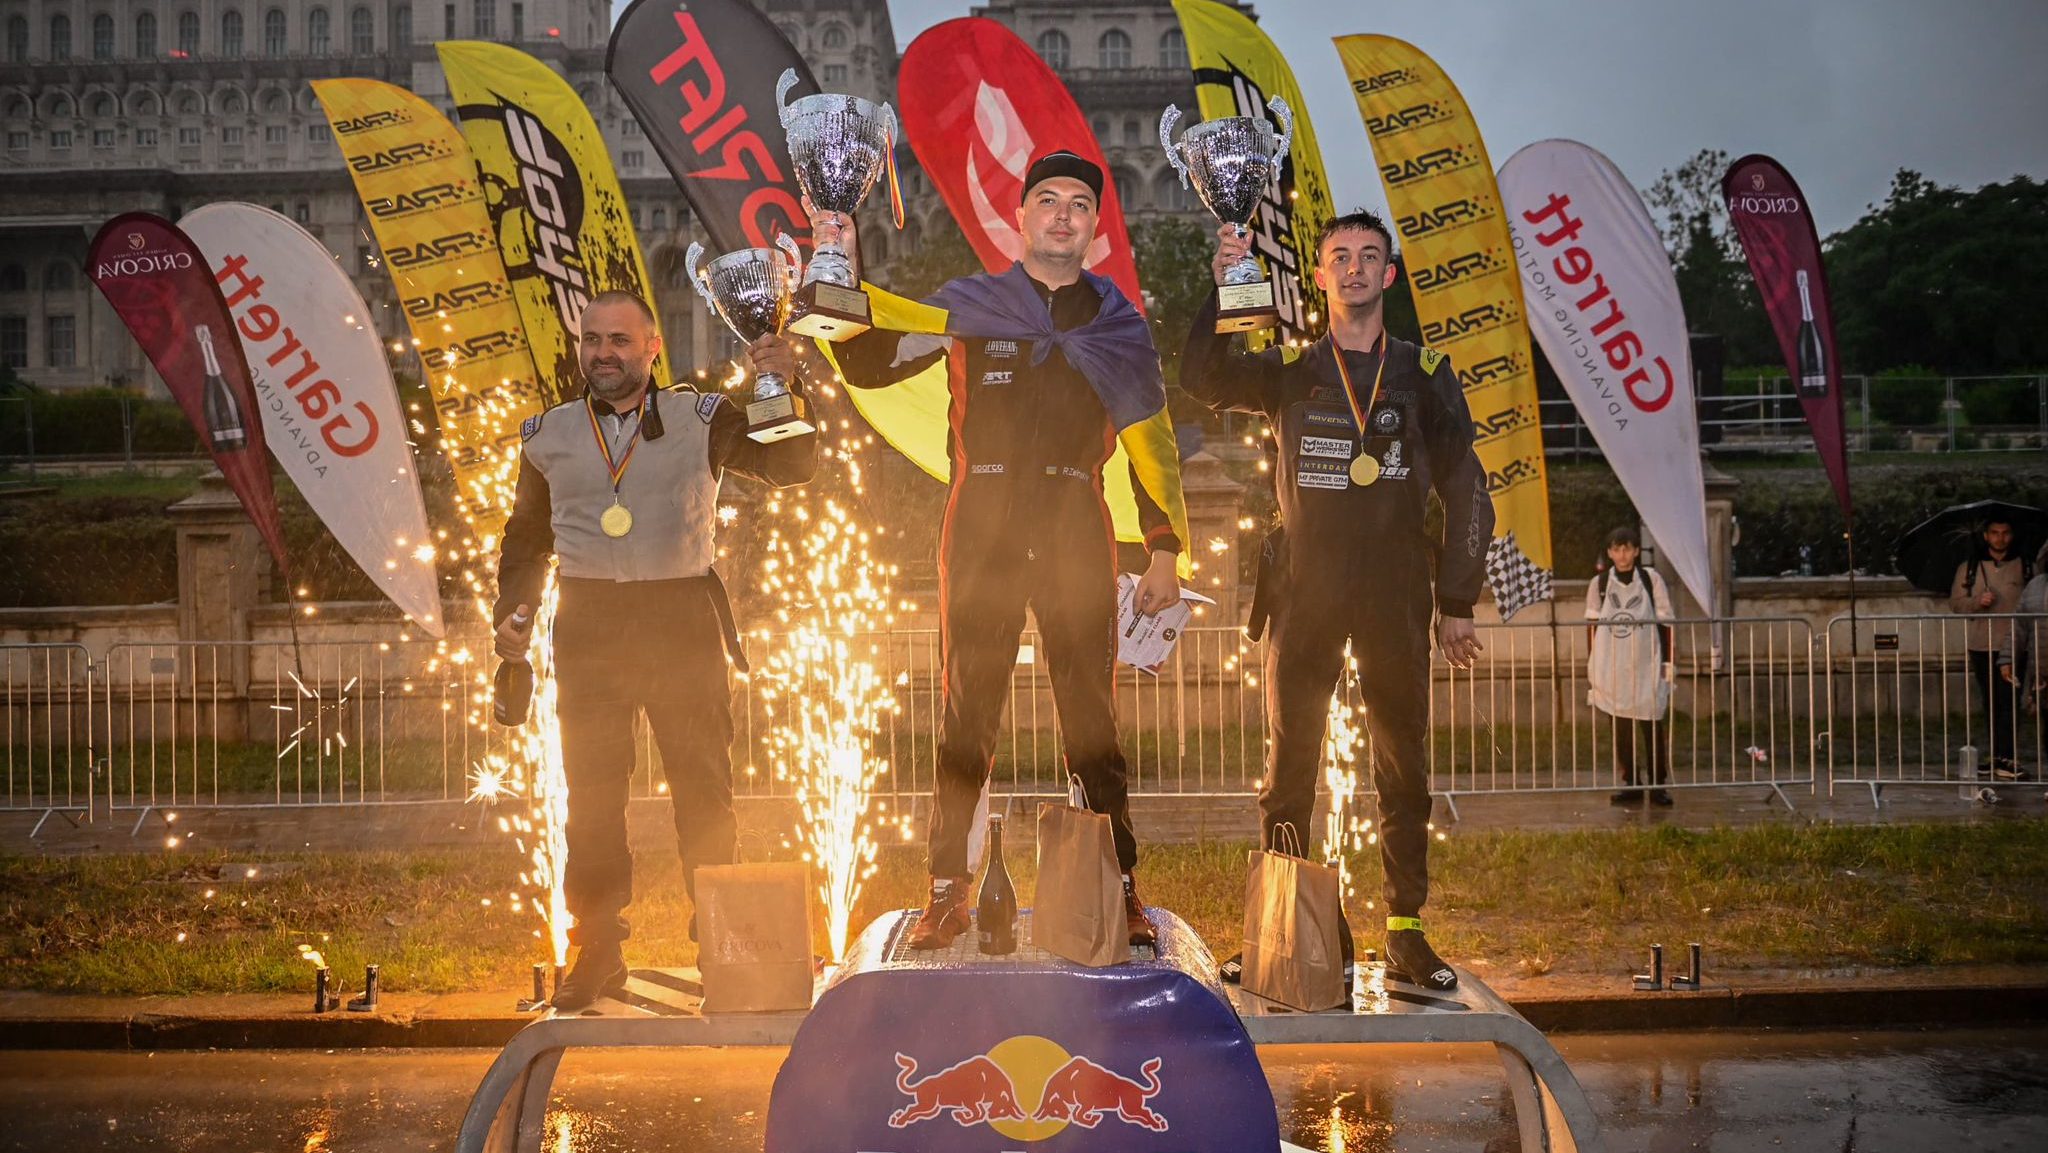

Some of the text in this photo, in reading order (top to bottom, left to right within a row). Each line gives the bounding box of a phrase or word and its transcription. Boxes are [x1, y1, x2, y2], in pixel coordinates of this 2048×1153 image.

[505, 107, 590, 345] shop
[1308, 414, 1350, 425] RAVENOL
[1316, 440, 1350, 449] MASTER
[1299, 461, 1348, 472] INTERDAX
[718, 940, 783, 952] CRICOVA
